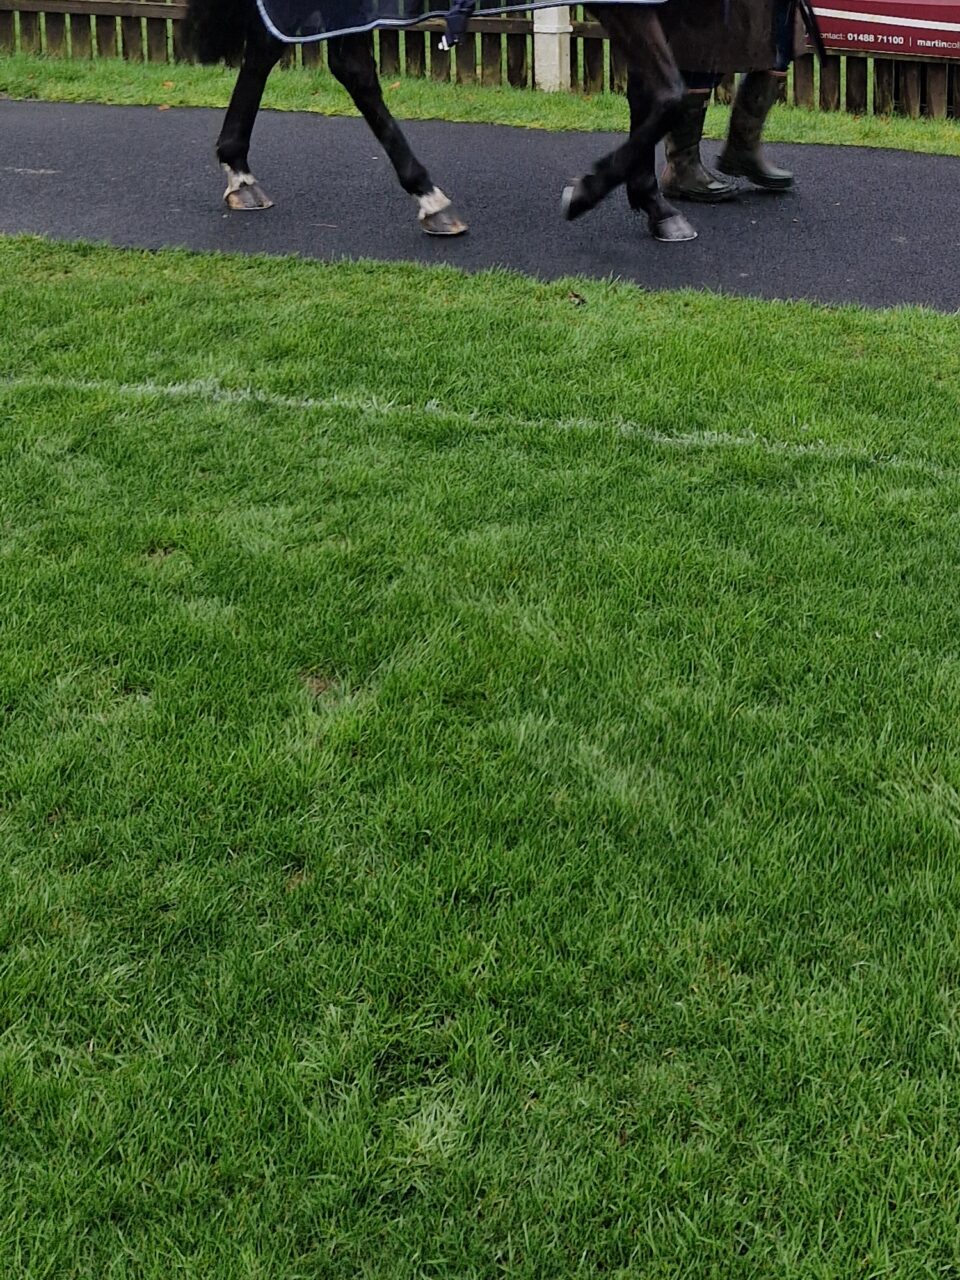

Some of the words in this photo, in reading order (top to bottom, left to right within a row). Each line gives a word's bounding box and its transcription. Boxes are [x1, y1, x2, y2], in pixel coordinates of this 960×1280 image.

[819, 31, 846, 41] ontact:
[847, 32, 875, 43] 01488
[877, 35, 904, 45] 71100
